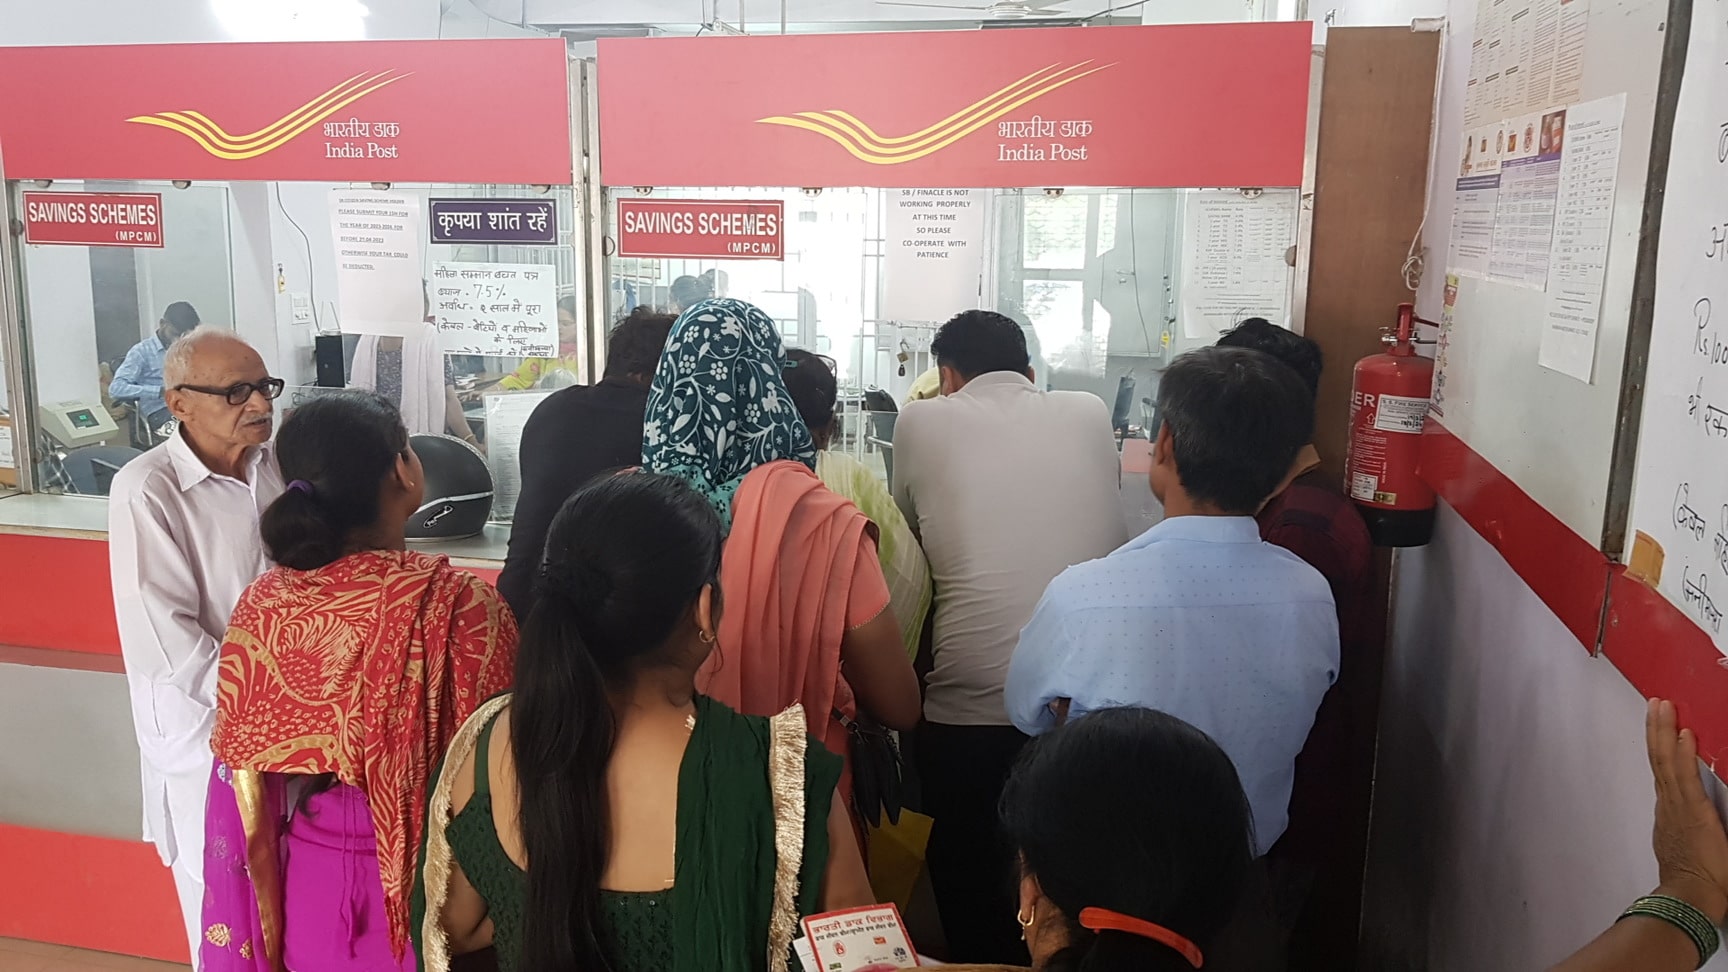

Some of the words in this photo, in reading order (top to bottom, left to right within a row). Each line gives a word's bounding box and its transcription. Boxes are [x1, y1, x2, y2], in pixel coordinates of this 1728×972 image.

[323, 117, 371, 137] भारतीय
[372, 122, 400, 137] डाक
[998, 115, 1057, 138] भारतीय
[1059, 120, 1093, 137] डाक
[324, 142, 364, 158] India
[366, 142, 399, 158] Post
[997, 143, 1045, 161] India
[1049, 143, 1088, 161] Post
[28, 202, 87, 223] SAVINGS
[89, 203, 156, 225] SCHEMES
[437, 212, 482, 237] कृपया
[487, 207, 522, 230] शांत
[526, 206, 548, 232] रहें
[624, 211, 694, 235] SAVINGS
[698, 212, 777, 236] SCHEMES
[115, 231, 157, 241] (MPCM)
[727, 242, 775, 254] (MPCM)
